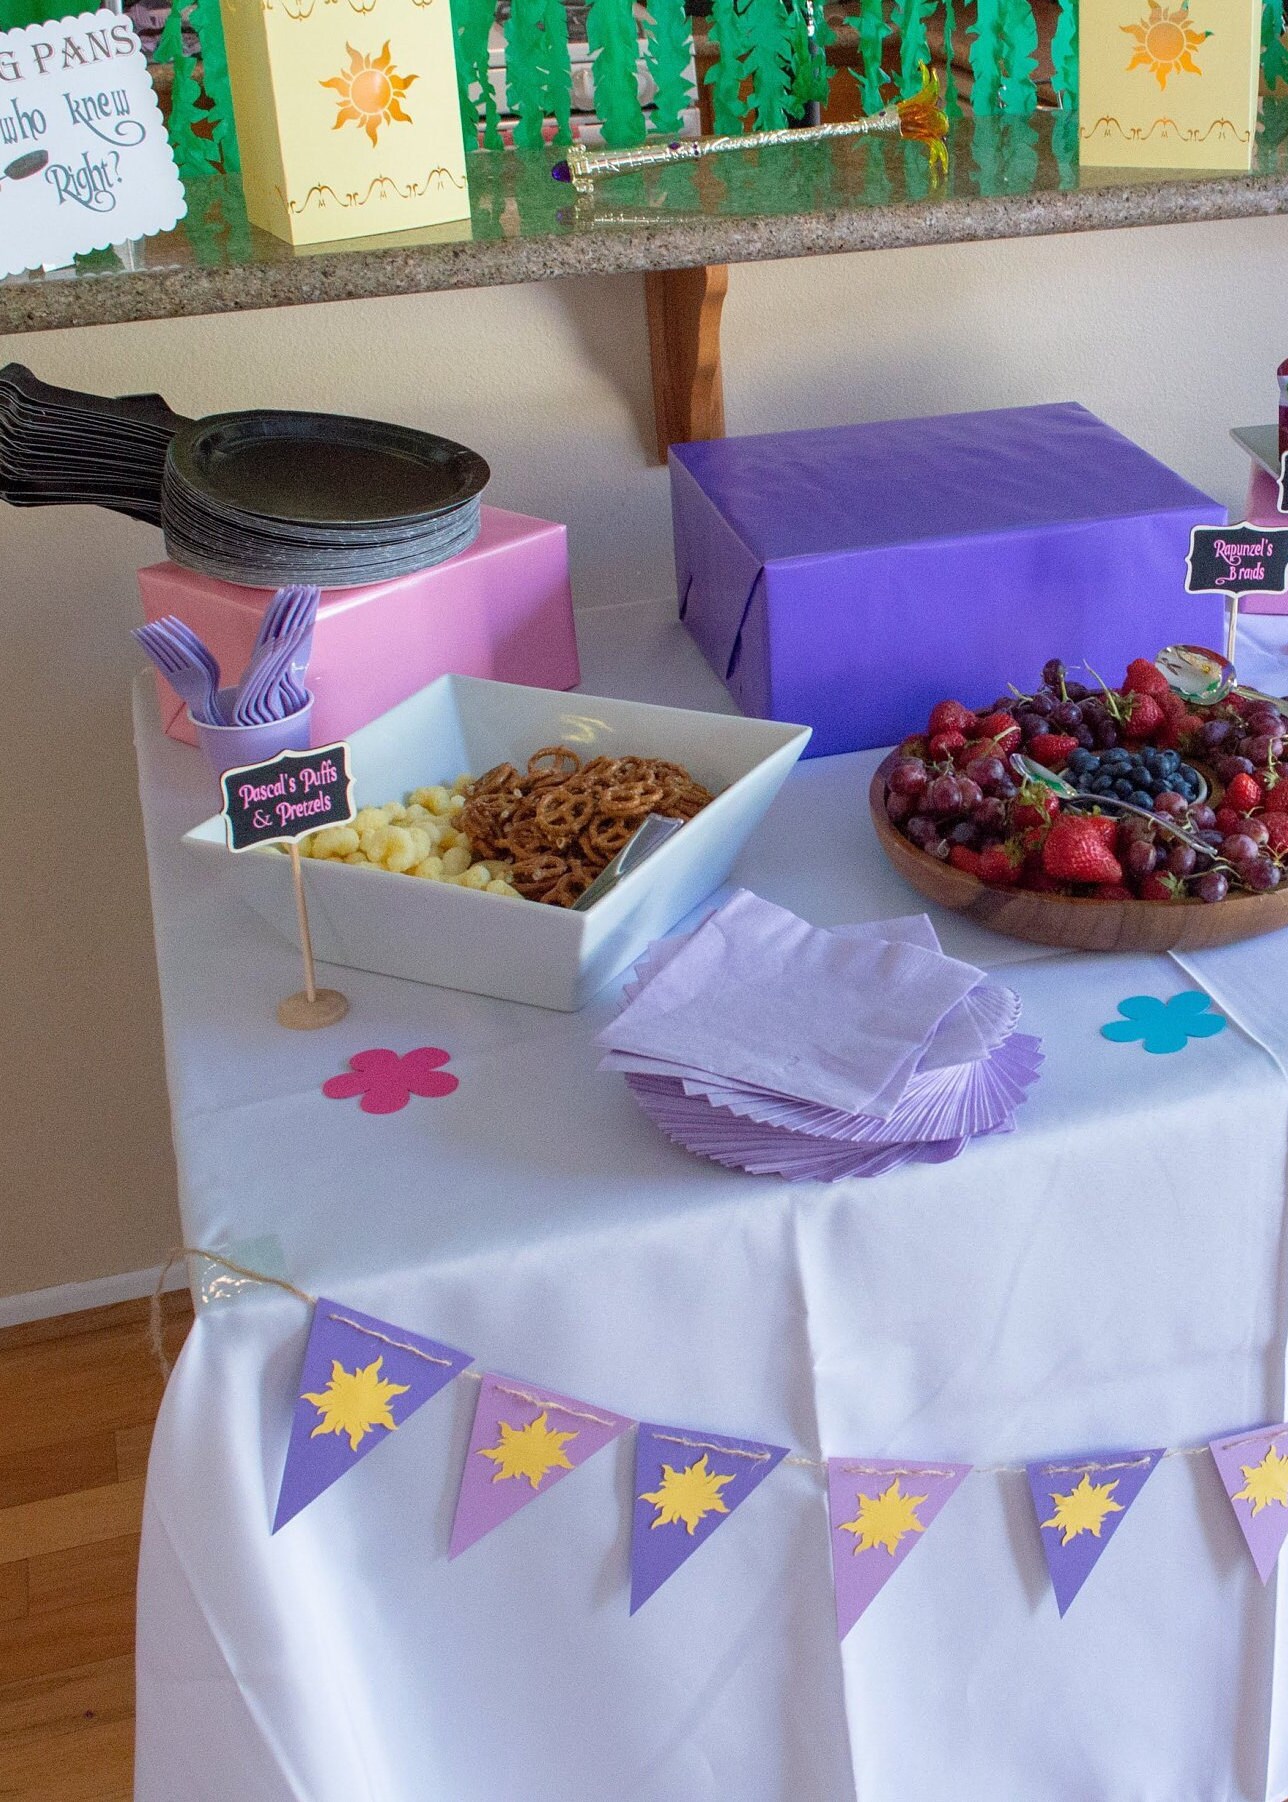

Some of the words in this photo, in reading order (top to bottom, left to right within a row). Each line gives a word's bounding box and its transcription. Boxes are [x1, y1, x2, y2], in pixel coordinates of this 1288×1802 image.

[31, 24, 135, 74] PANS
[62, 88, 146, 147] knew
[45, 150, 123, 213] Right?
[1213, 538, 1274, 566] Rapunzel's
[238, 773, 297, 810] Pascal's
[299, 759, 338, 795] Puffs
[252, 809, 273, 829] &
[275, 790, 332, 828] Pretzels
